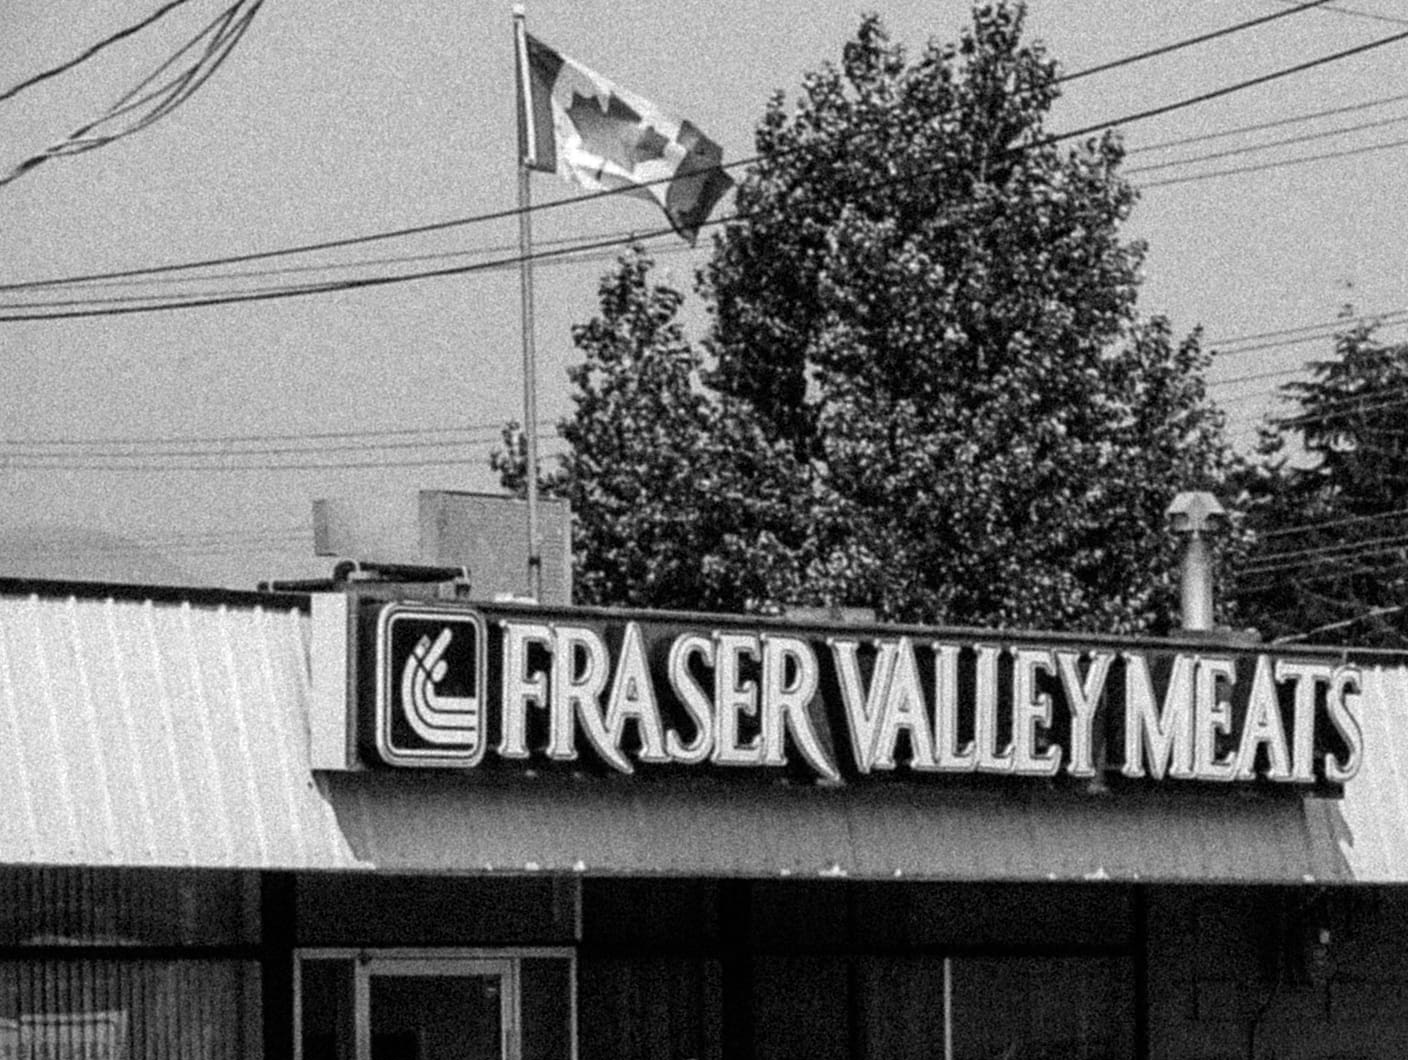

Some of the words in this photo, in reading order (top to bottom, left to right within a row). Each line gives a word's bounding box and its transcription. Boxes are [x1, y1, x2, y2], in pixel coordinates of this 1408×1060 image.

[498, 620, 842, 784] FRASER
[826, 635, 1116, 776] VALLEY
[1122, 652, 1363, 783] MEATS
